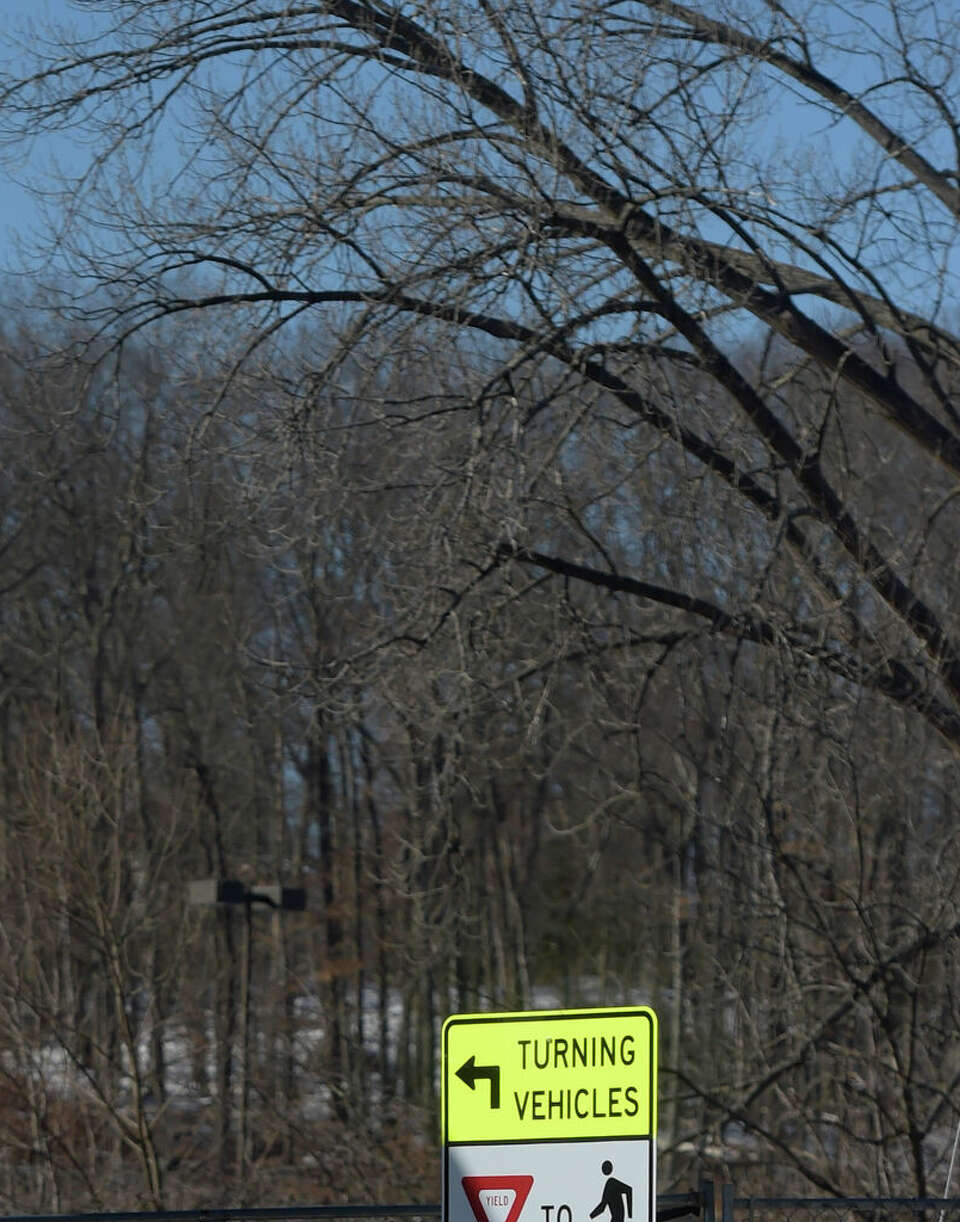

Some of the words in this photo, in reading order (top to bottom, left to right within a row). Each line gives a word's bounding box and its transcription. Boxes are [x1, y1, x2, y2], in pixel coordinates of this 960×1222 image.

[518, 1035, 635, 1070] TURNING
[514, 1086, 639, 1120] VEHICLES
[486, 1195, 509, 1207] YIELD
